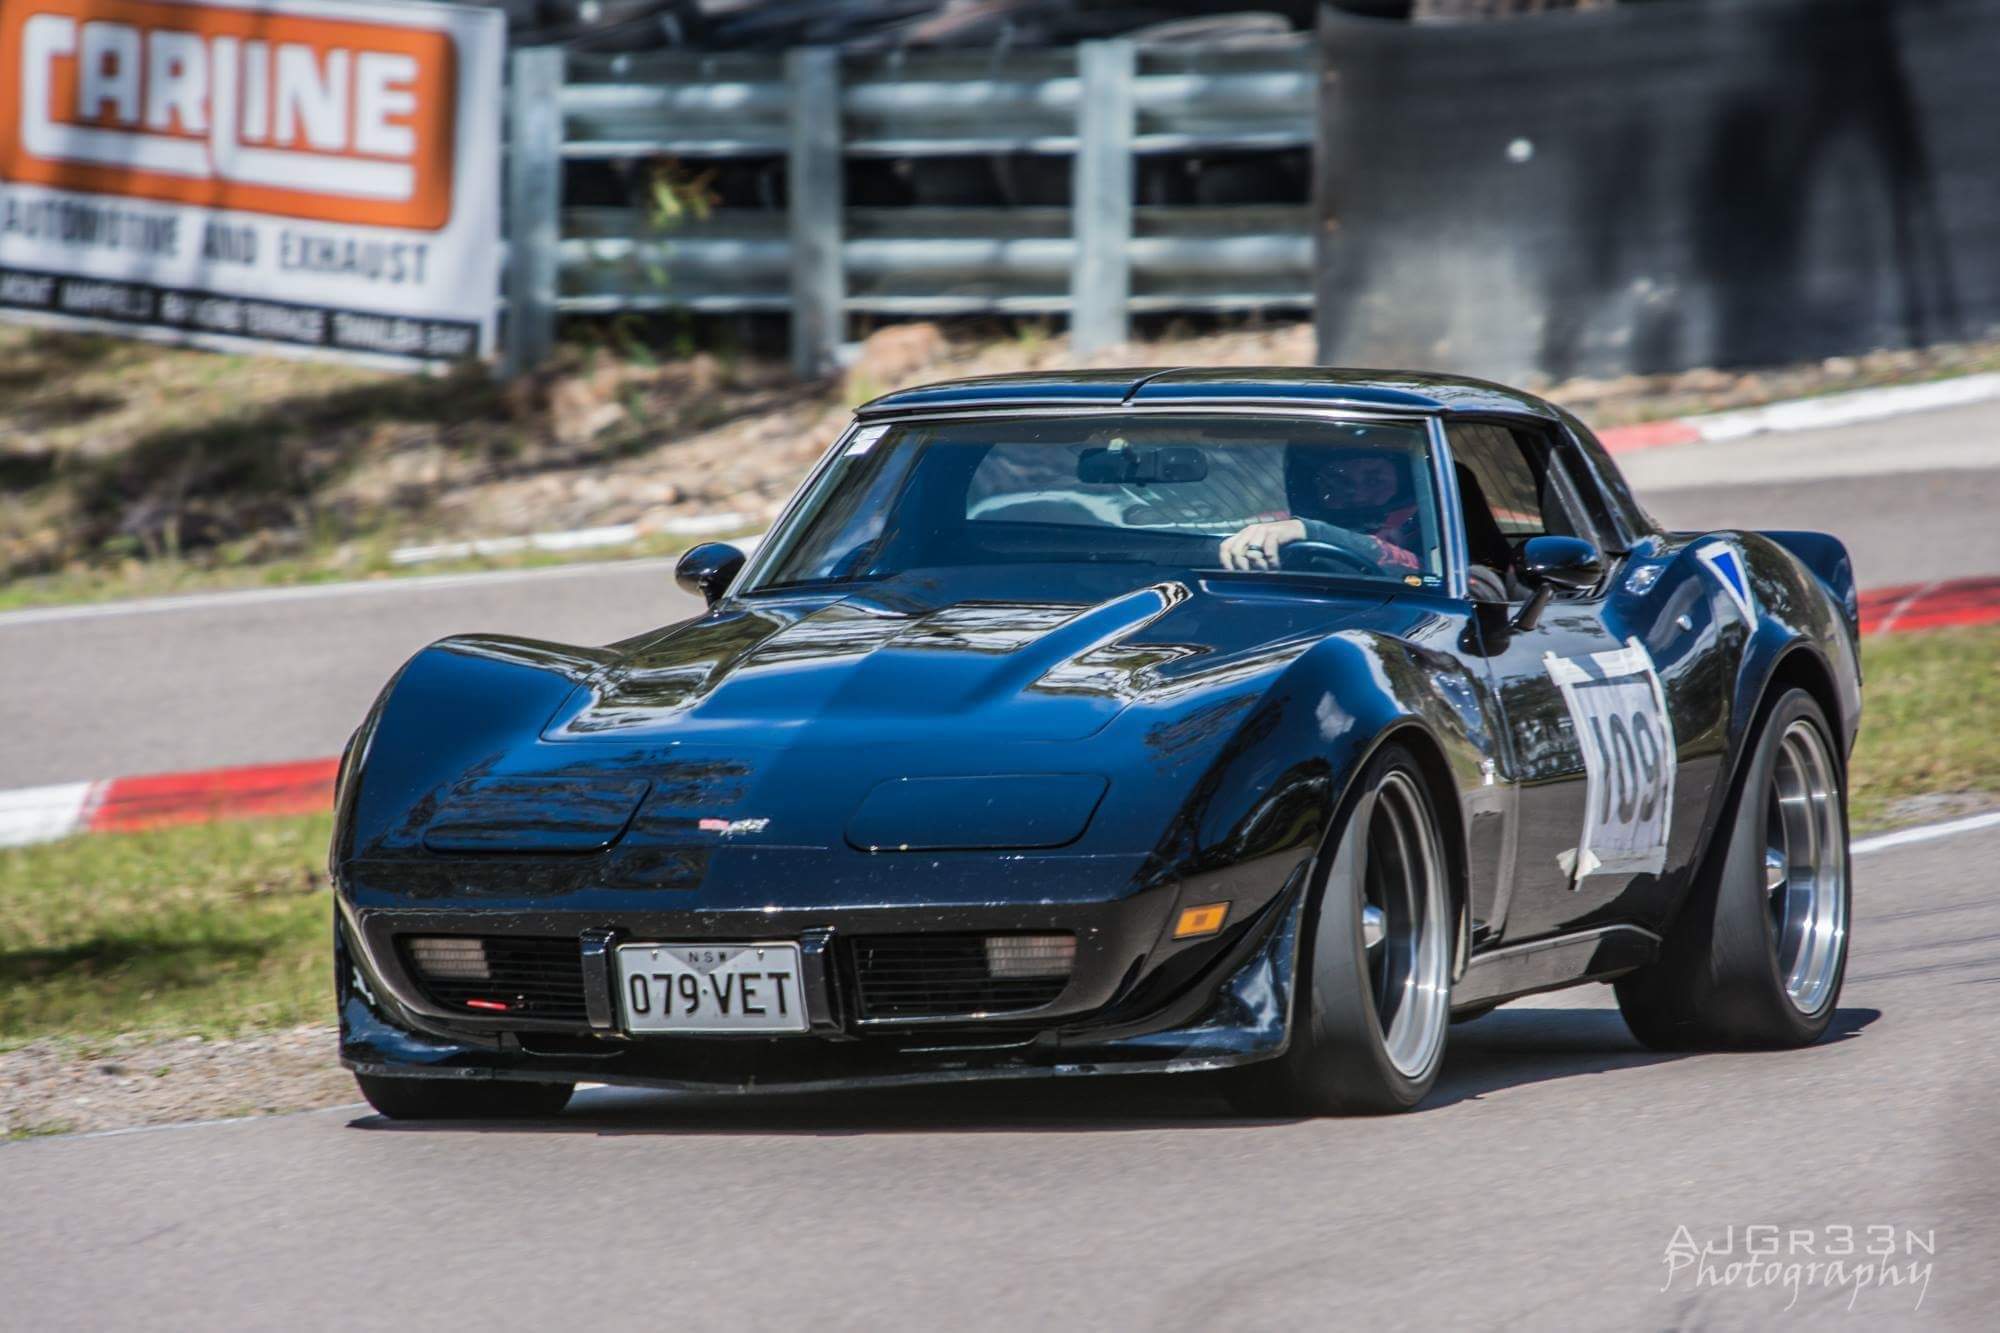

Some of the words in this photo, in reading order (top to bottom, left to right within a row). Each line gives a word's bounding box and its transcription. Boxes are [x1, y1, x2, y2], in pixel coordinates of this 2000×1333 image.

[21, 12, 419, 202] CARLINE
[203, 217, 259, 266] AND
[280, 230, 430, 285] EXHAUST
[1590, 710, 1661, 826] 109
[689, 951, 728, 963] NSW
